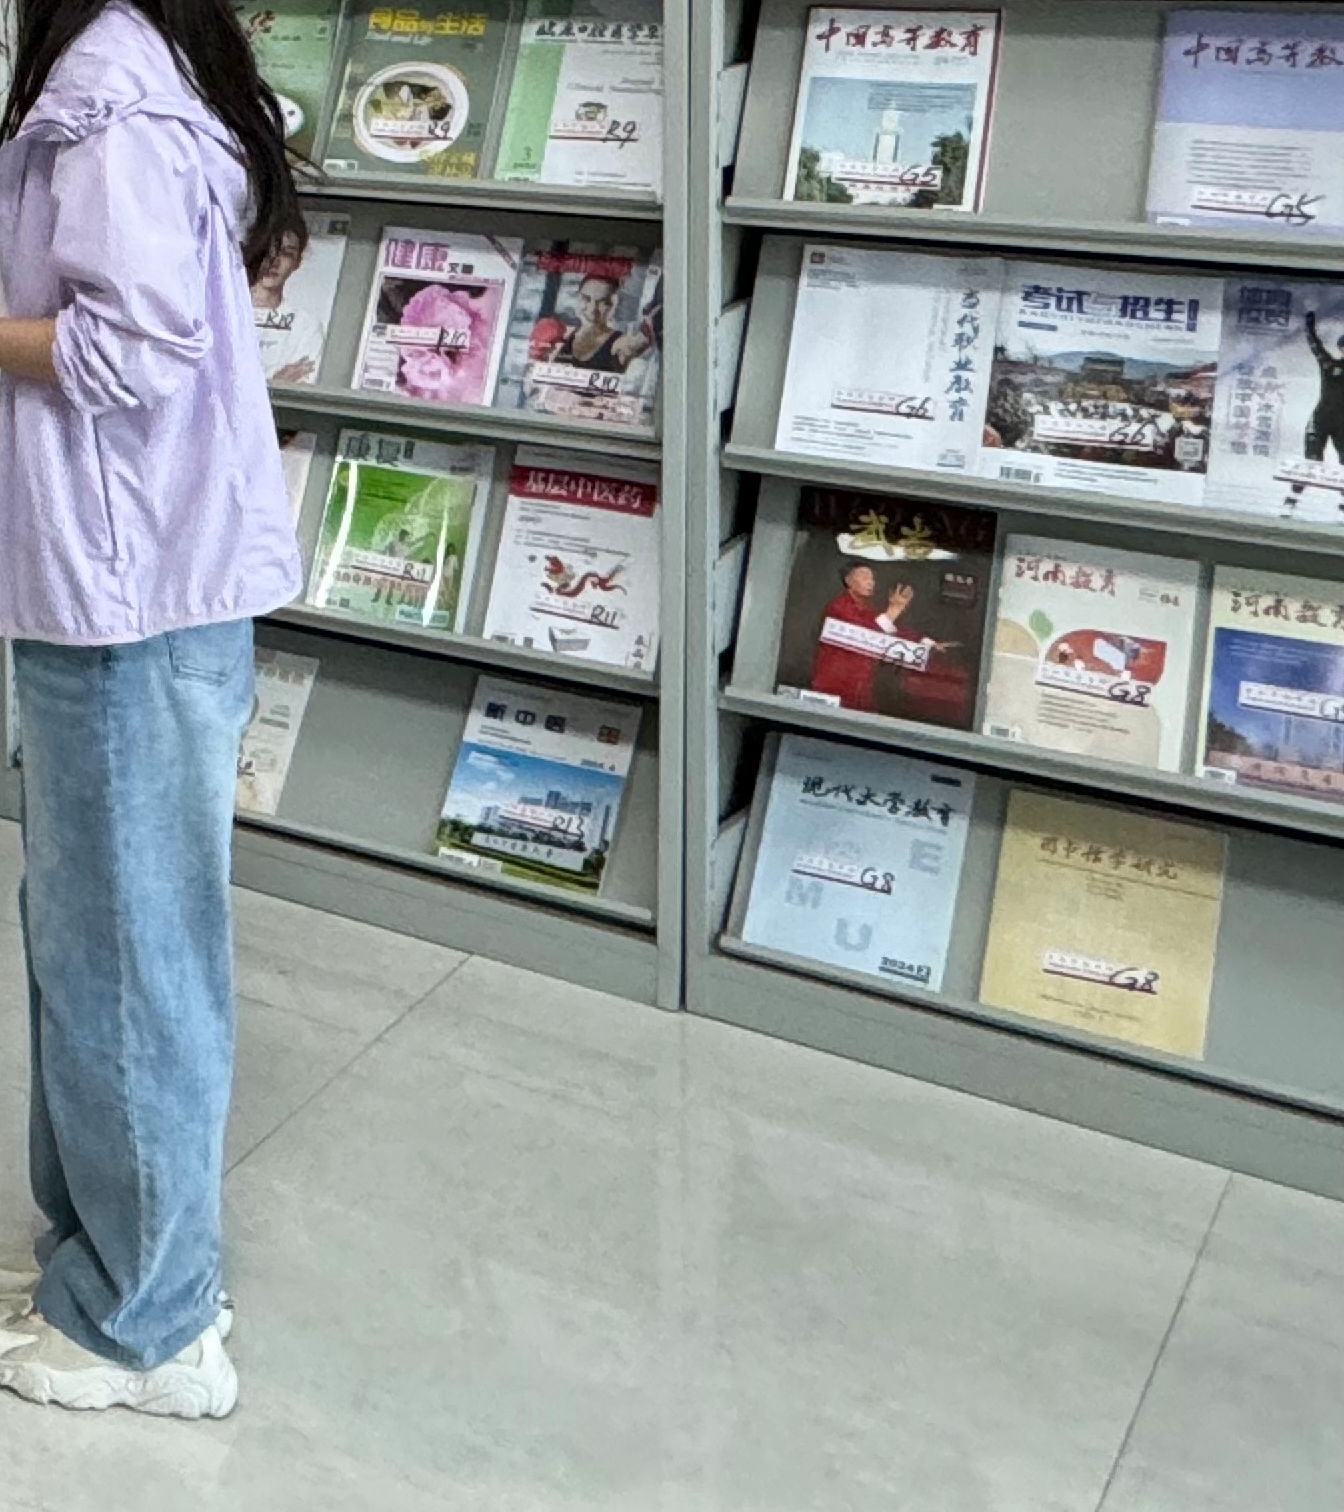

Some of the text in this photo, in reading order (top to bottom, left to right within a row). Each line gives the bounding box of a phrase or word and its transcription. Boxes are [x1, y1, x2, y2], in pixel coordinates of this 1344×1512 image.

[815, 17, 986, 56] 中国高等教育
[899, 164, 940, 187] G5
[1015, 555, 1118, 598] 河南教育
[486, 701, 567, 734] 新中医
[802, 775, 953, 827] 现代大学教育
